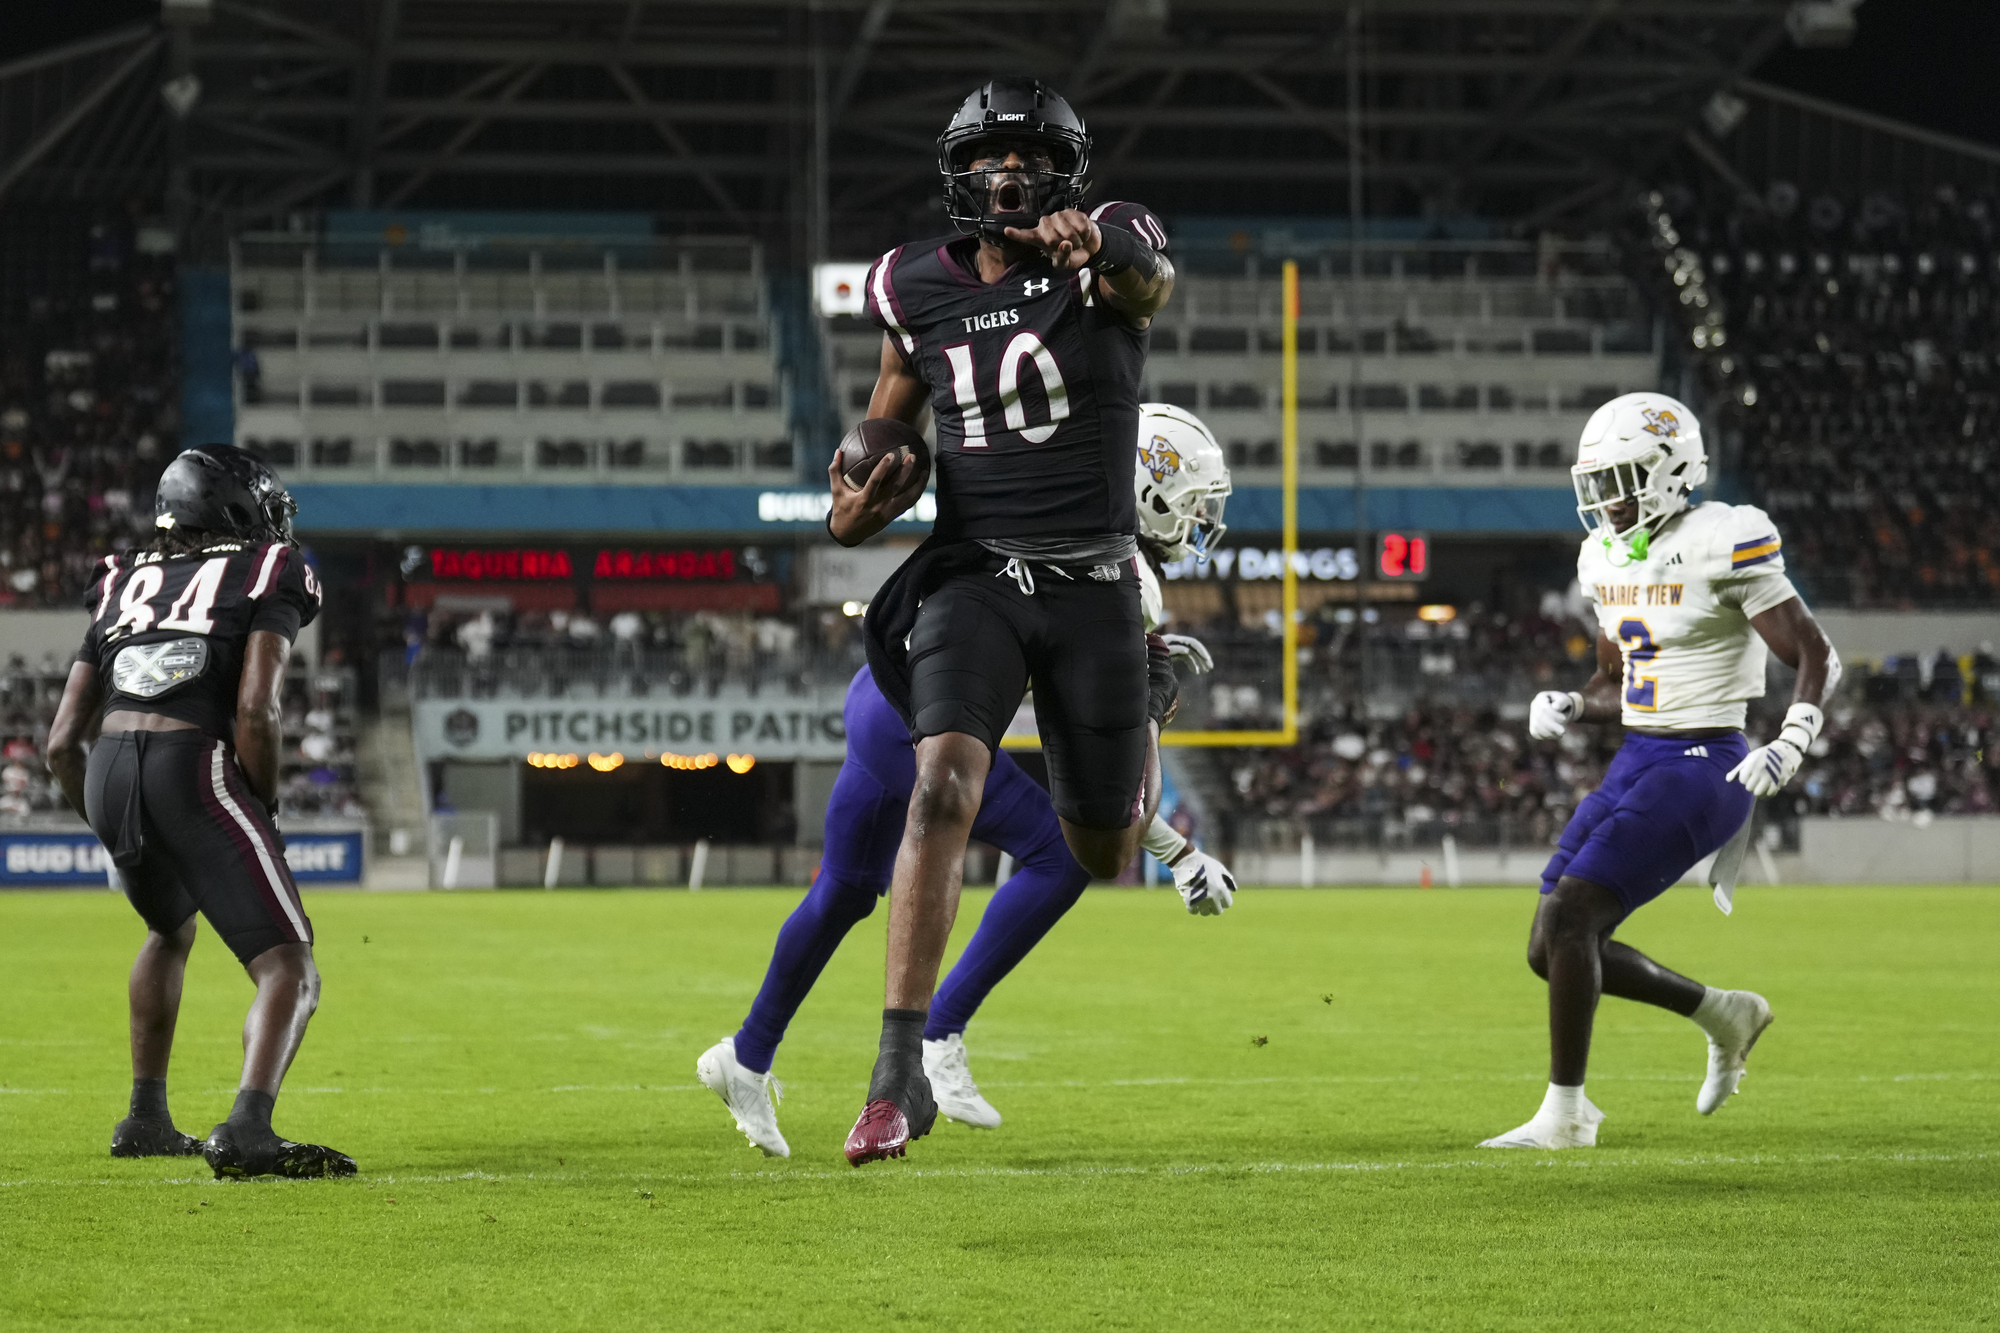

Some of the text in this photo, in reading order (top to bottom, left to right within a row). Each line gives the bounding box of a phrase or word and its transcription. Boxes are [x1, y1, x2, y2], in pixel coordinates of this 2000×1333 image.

[996, 113, 1026, 122] LIGHT
[1129, 213, 1167, 251] 10
[961, 308, 1020, 333] TIGERS
[941, 329, 1071, 448] 10
[1380, 533, 1426, 577] 21
[106, 556, 231, 642] 84
[303, 563, 323, 607] 84
[1646, 583, 1684, 606] VIEW
[1616, 616, 1662, 712] 2
[505, 710, 715, 742] PITCHSIDE
[6, 844, 73, 873] BUD
